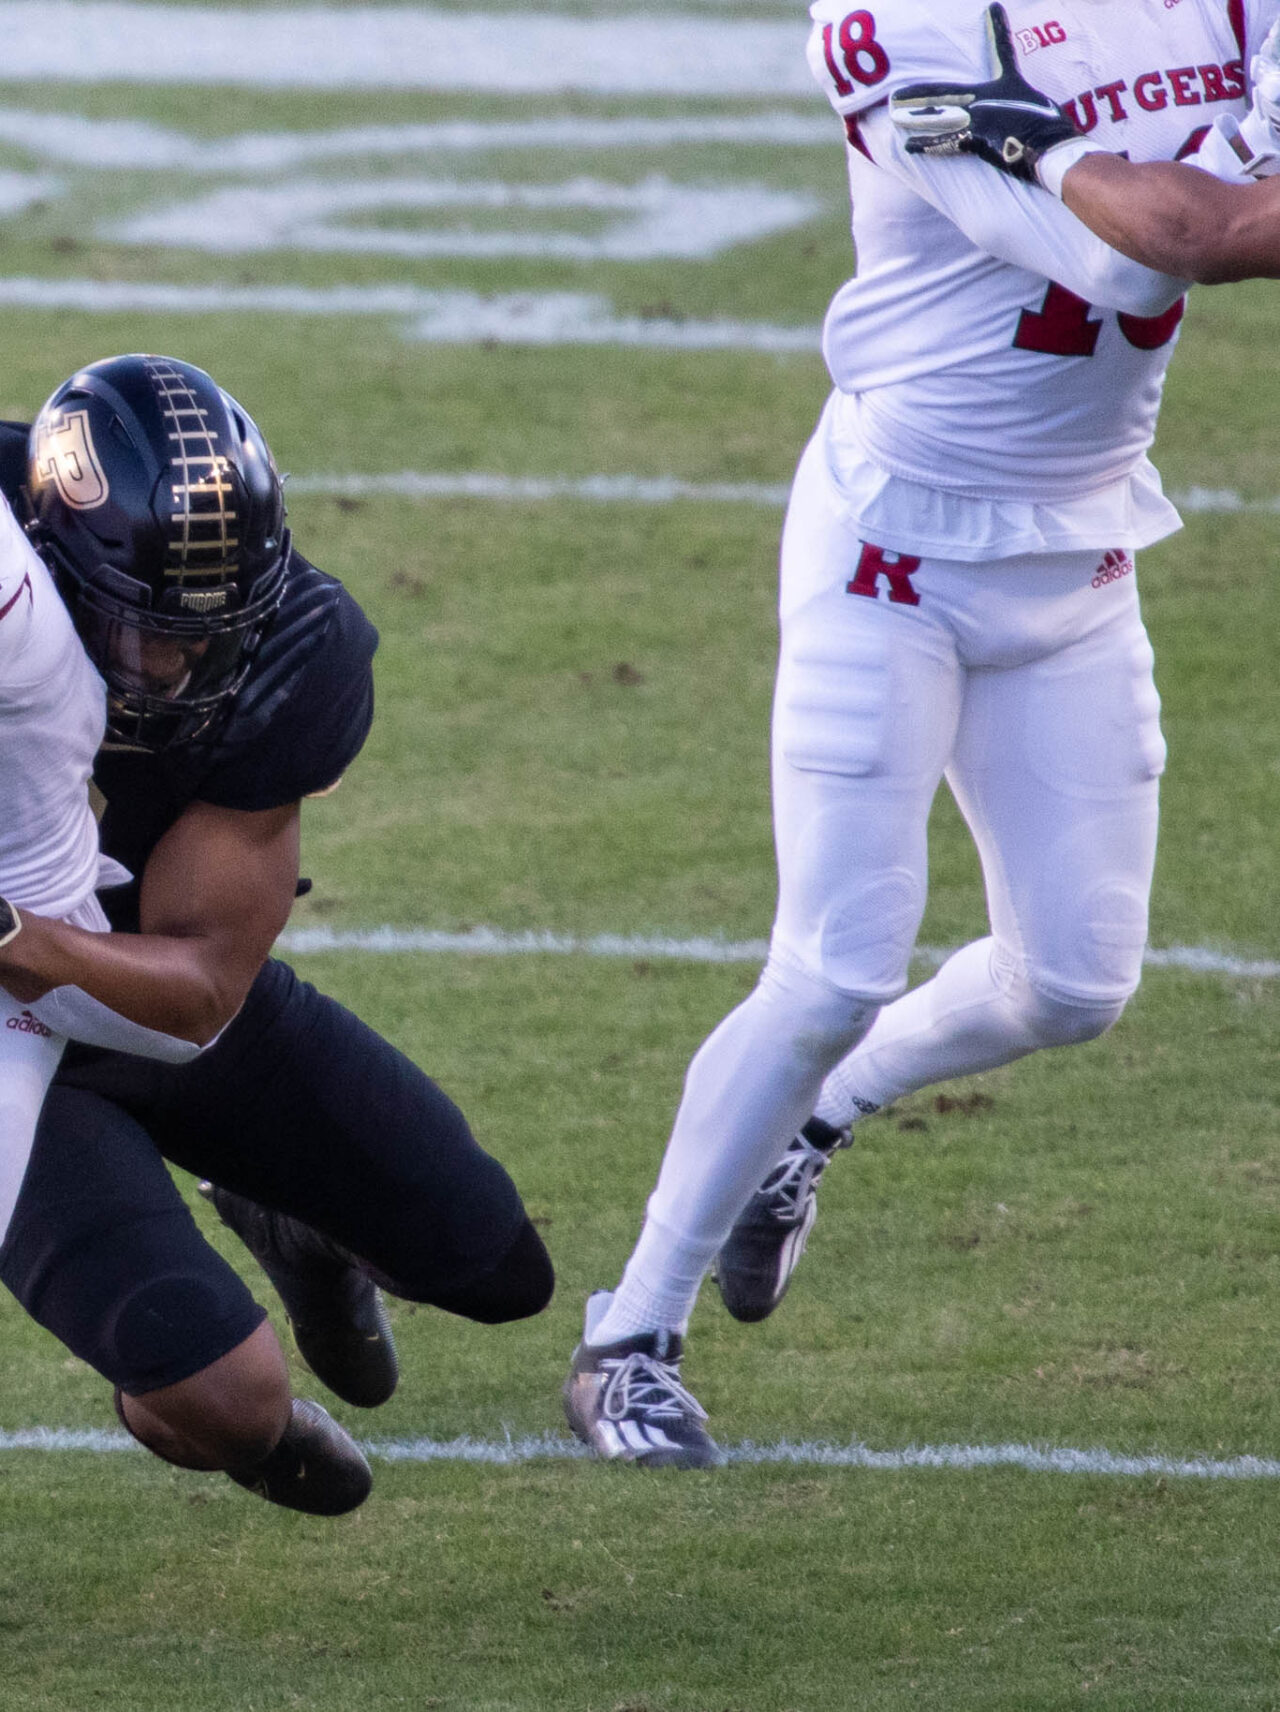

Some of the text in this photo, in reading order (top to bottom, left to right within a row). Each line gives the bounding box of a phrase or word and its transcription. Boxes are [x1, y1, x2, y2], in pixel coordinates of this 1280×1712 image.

[822, 9, 890, 97] 18
[1061, 58, 1247, 134] UTGERS
[35, 409, 109, 509] P
[846, 540, 922, 607] R
[1091, 560, 1133, 589] adidas
[6, 1015, 52, 1038] adida
